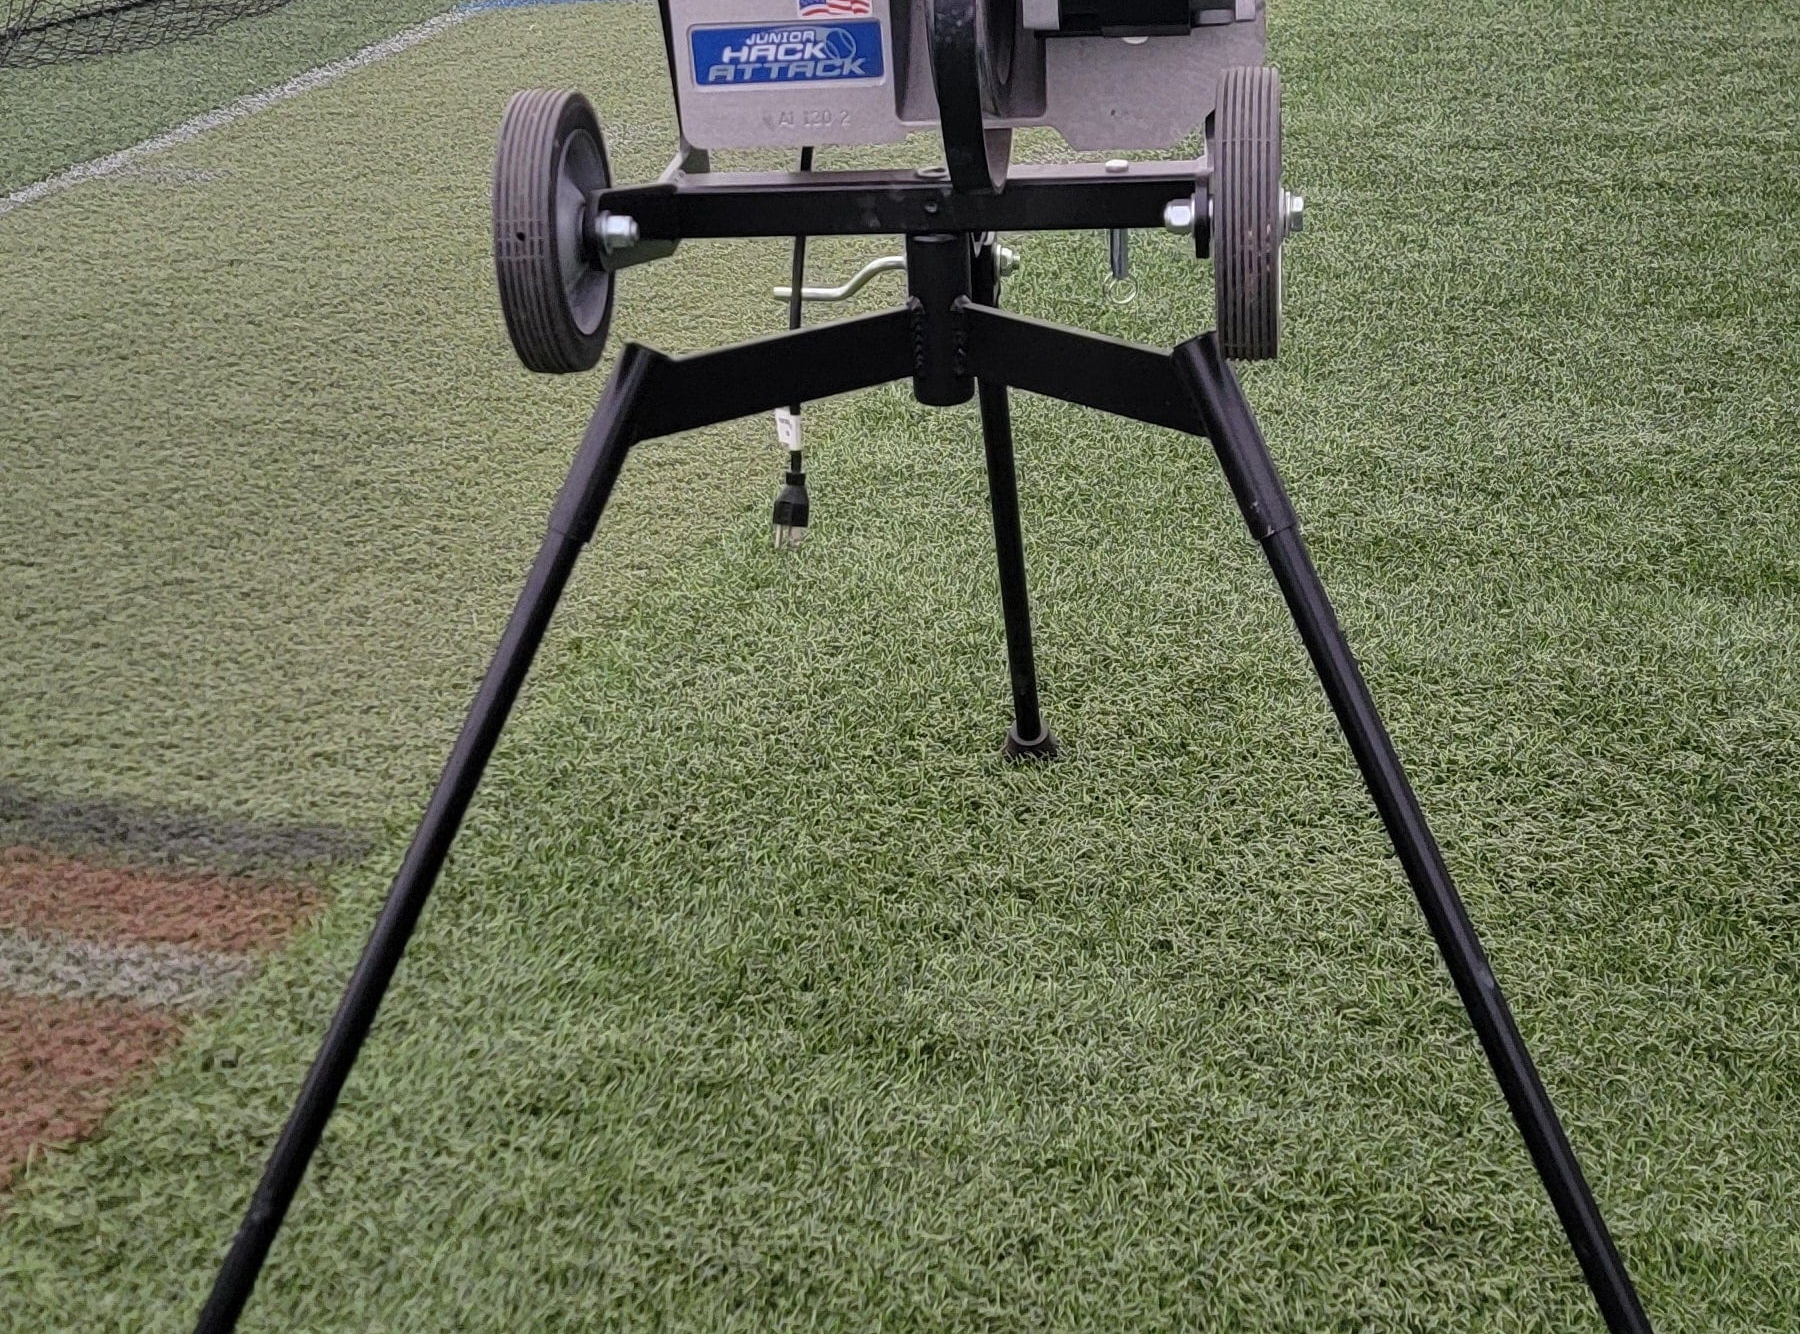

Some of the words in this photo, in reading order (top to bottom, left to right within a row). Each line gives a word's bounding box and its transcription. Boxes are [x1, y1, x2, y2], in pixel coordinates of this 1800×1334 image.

[745, 30, 815, 45] JUNIOR
[722, 42, 827, 64] HACK
[708, 57, 866, 82] ATTACK
